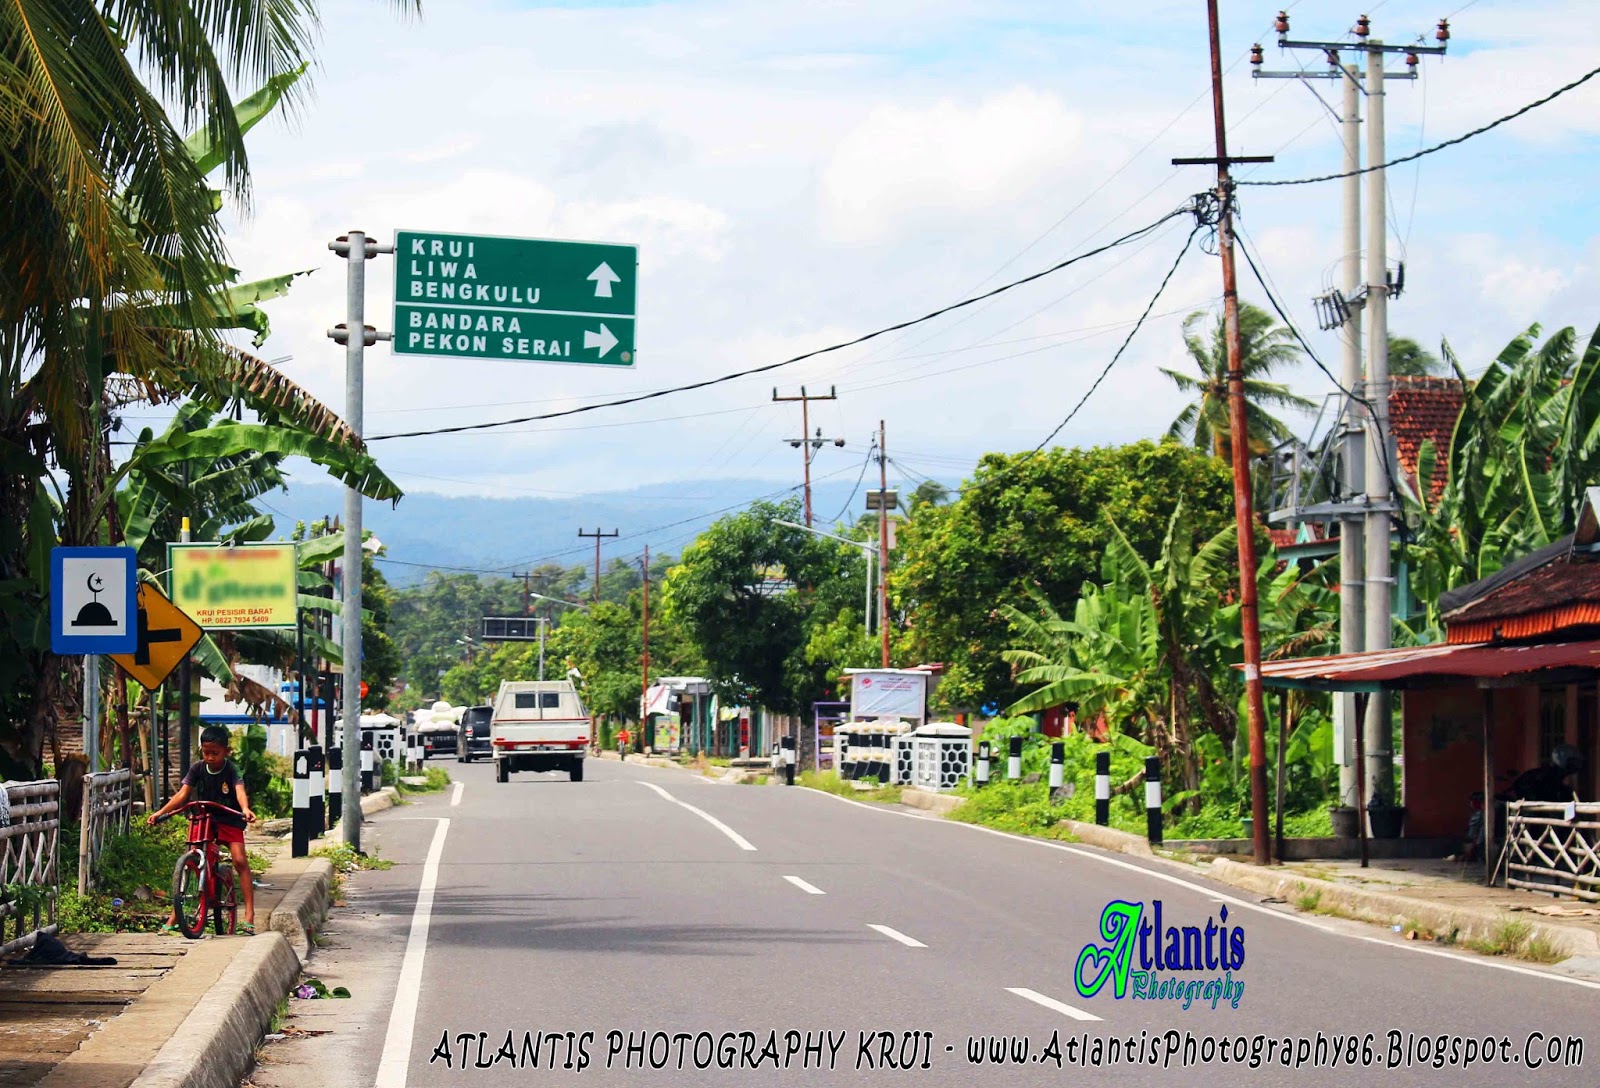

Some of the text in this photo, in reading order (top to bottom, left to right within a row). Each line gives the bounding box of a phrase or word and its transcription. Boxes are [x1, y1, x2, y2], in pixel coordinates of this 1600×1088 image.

[411, 238, 474, 258] KRUI
[411, 260, 477, 279] LIWA
[410, 281, 541, 304] BENGKULU
[409, 311, 521, 333] BANDARA
[409, 332, 571, 356] PEKON SERAI
[216, 608, 246, 616] PESISIR
